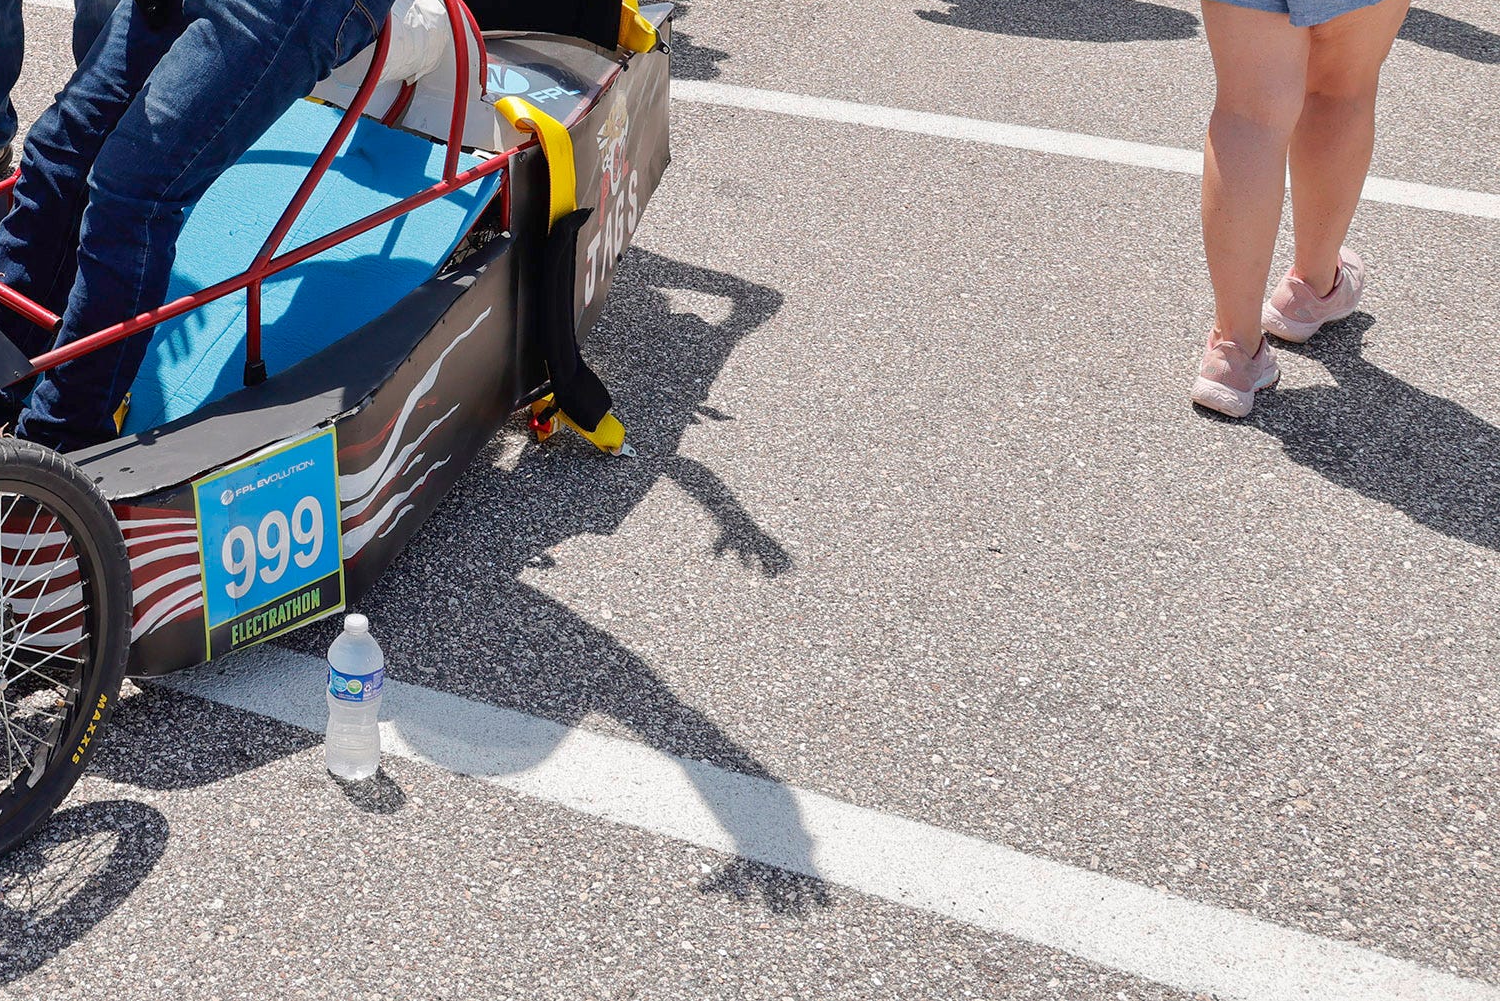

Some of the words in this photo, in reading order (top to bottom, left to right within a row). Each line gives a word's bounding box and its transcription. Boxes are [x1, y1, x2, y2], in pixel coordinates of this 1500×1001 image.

[526, 86, 581, 104] FPL
[585, 169, 638, 308] JAGS
[235, 483, 257, 497] FPL
[257, 459, 315, 490] EVOLUTION
[221, 496, 325, 600] 999
[231, 587, 321, 647] ELECTRATHON
[71, 692, 108, 765] MAXXIS
